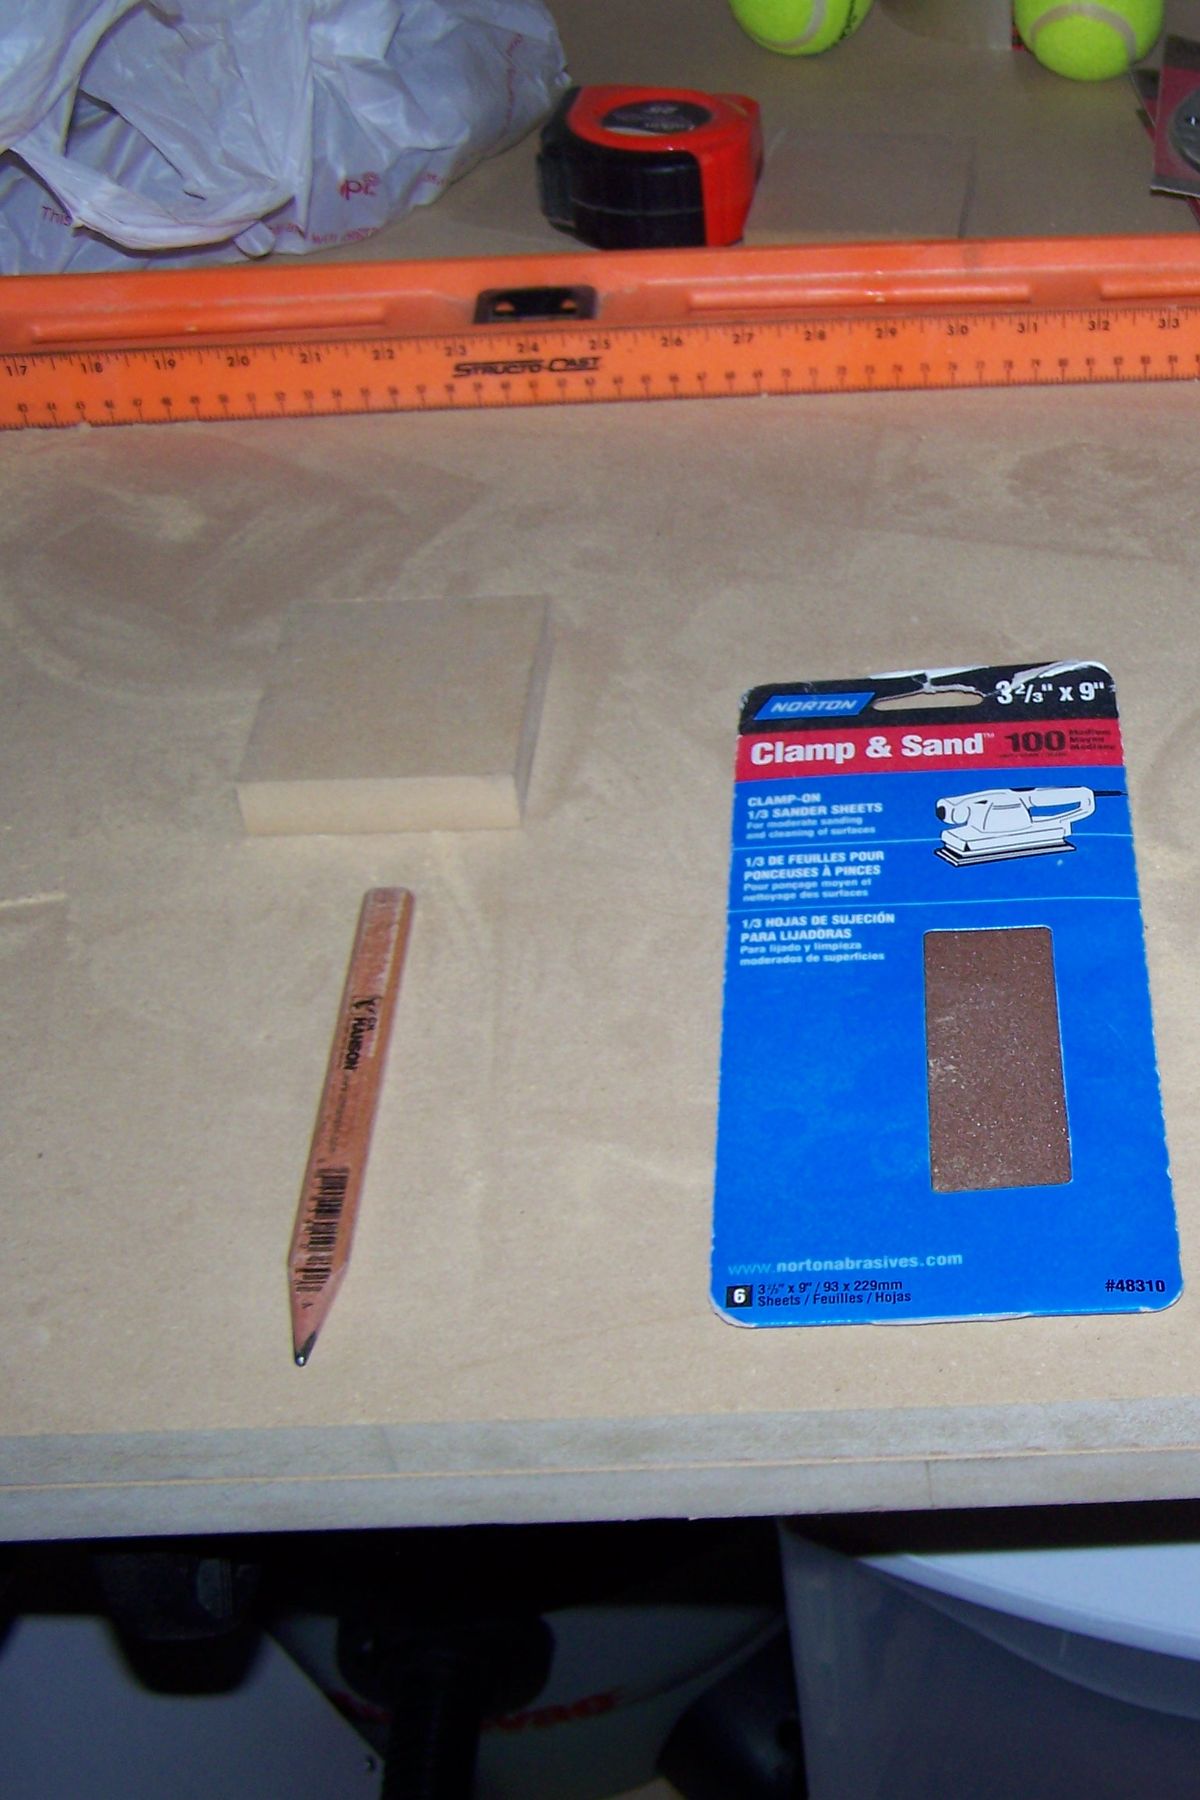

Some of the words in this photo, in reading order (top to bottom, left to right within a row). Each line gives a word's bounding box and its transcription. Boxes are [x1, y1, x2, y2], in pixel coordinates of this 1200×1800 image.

[1059, 687, 1074, 701] x
[770, 699, 857, 714] NORTON
[751, 740, 856, 765] Clamp
[865, 735, 892, 758] &
[1004, 730, 1066, 752] 100
[747, 793, 821, 807] CLAMP-ON
[748, 809, 769, 820] 1/3
[772, 805, 828, 818] SANDER
[830, 802, 883, 815] SHEETS
[830, 826, 876, 835] surfaces
[745, 856, 765, 867] 1/3
[768, 855, 784, 866] DE
[788, 852, 846, 865] FEUILLES
[849, 850, 884, 862] POUR
[744, 867, 819, 881] PONCEUSES
[822, 864, 831, 877] À
[835, 865, 881, 877] PINCES
[743, 883, 769, 891] Pour
[821, 878, 858, 888] moyen
[861, 878, 872, 886] et
[799, 891, 819, 899] des
[822, 889, 868, 898] surfaces
[742, 918, 762, 929] 1/3
[765, 916, 808, 928] HOJAS
[811, 915, 828, 926] DE
[831, 910, 895, 925] SUJECIÓN
[740, 931, 776, 943] PARA
[780, 928, 852, 941] LIJADORAS
[740, 945, 766, 954] Para
[804, 944, 811, 953] y
[813, 941, 862, 952] limpieza
[805, 953, 820, 963] de
[822, 952, 885, 964] superficies
[788, 1285, 794, 1294] x
[823, 1281, 839, 1292] 93
[843, 1283, 849, 1292] x
[853, 1280, 902, 1292] 229mm
[1105, 1279, 1166, 1293] #48310
[733, 1288, 746, 1304] 6
[758, 1295, 800, 1307] Sheets
[813, 1292, 863, 1305] Feuilles
[875, 1291, 912, 1305] Hojas
